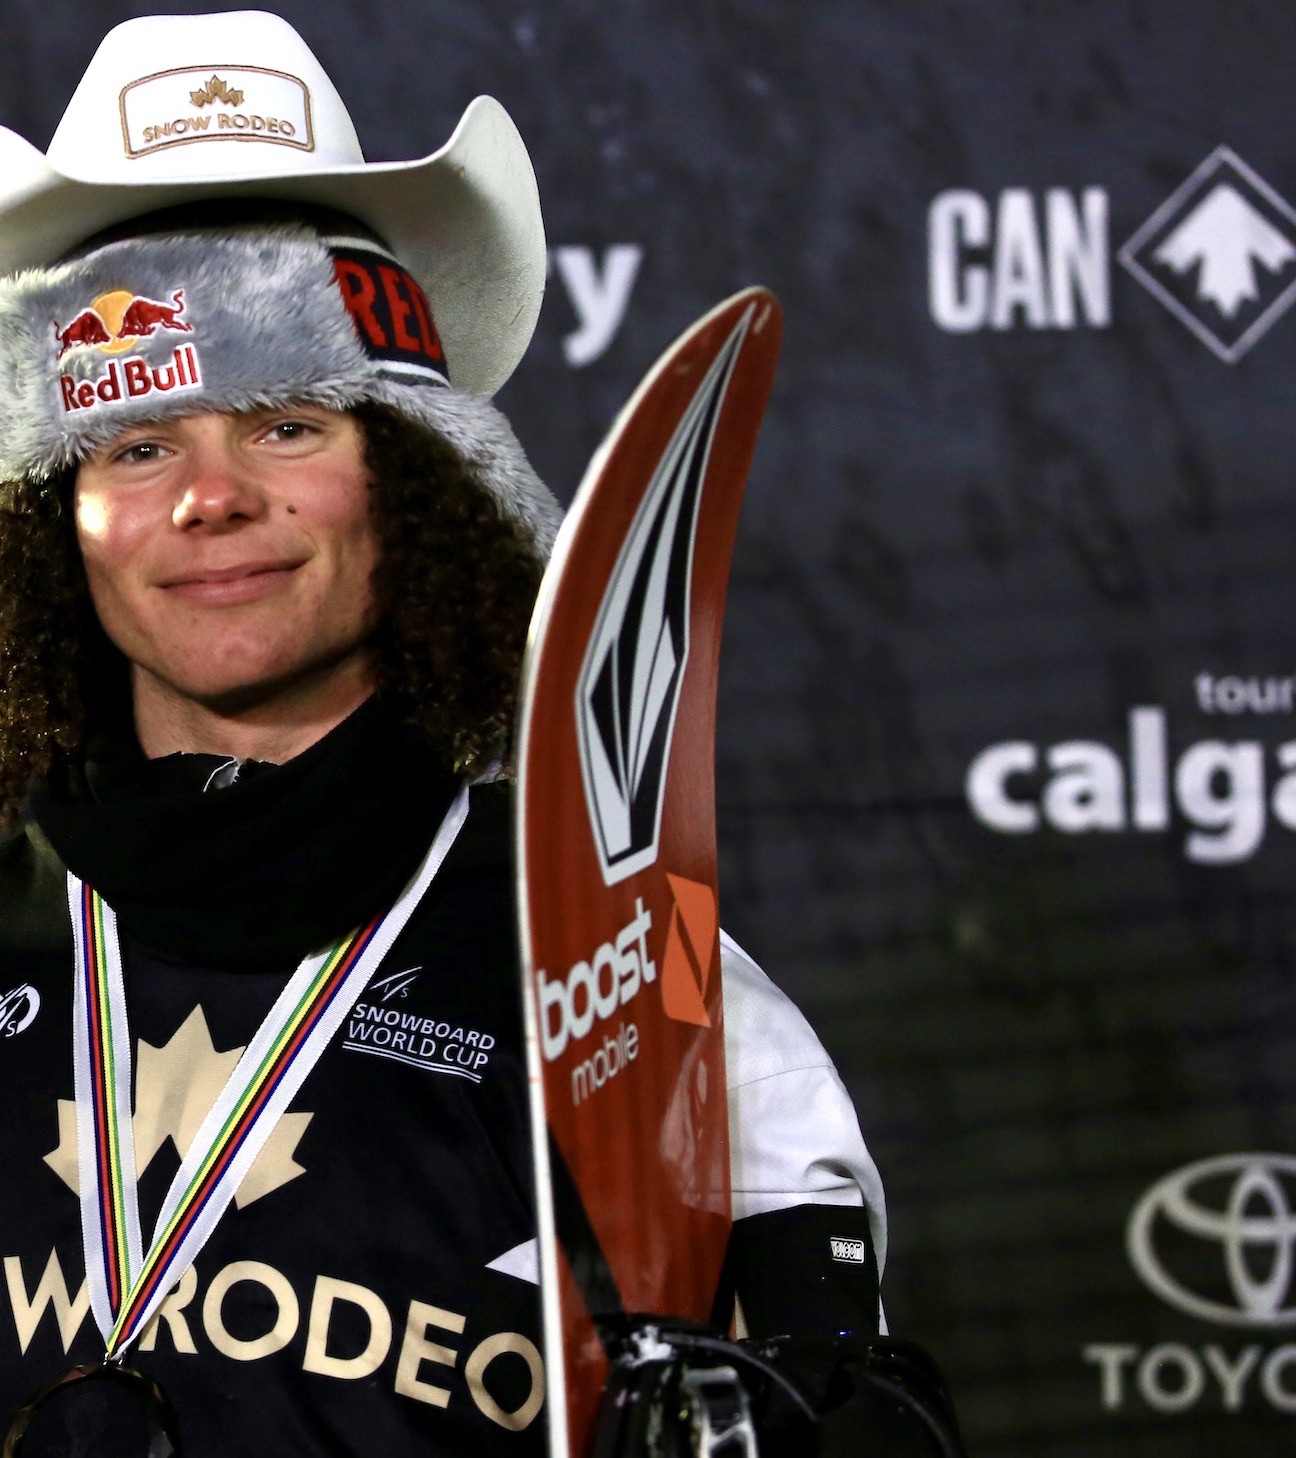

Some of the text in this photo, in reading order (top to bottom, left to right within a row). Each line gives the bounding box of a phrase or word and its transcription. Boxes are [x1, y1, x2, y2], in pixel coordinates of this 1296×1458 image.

[143, 113, 296, 144] SNOW RODEO
[927, 187, 1111, 333] CAN
[61, 347, 198, 411] Red Bull
[537, 896, 656, 1062] boost
[348, 1020, 490, 1070] WORLD CUP
[353, 1003, 496, 1050] SNOWBOARD
[571, 1022, 639, 1106] mobile
[138, 1260, 546, 1432] RODEO
